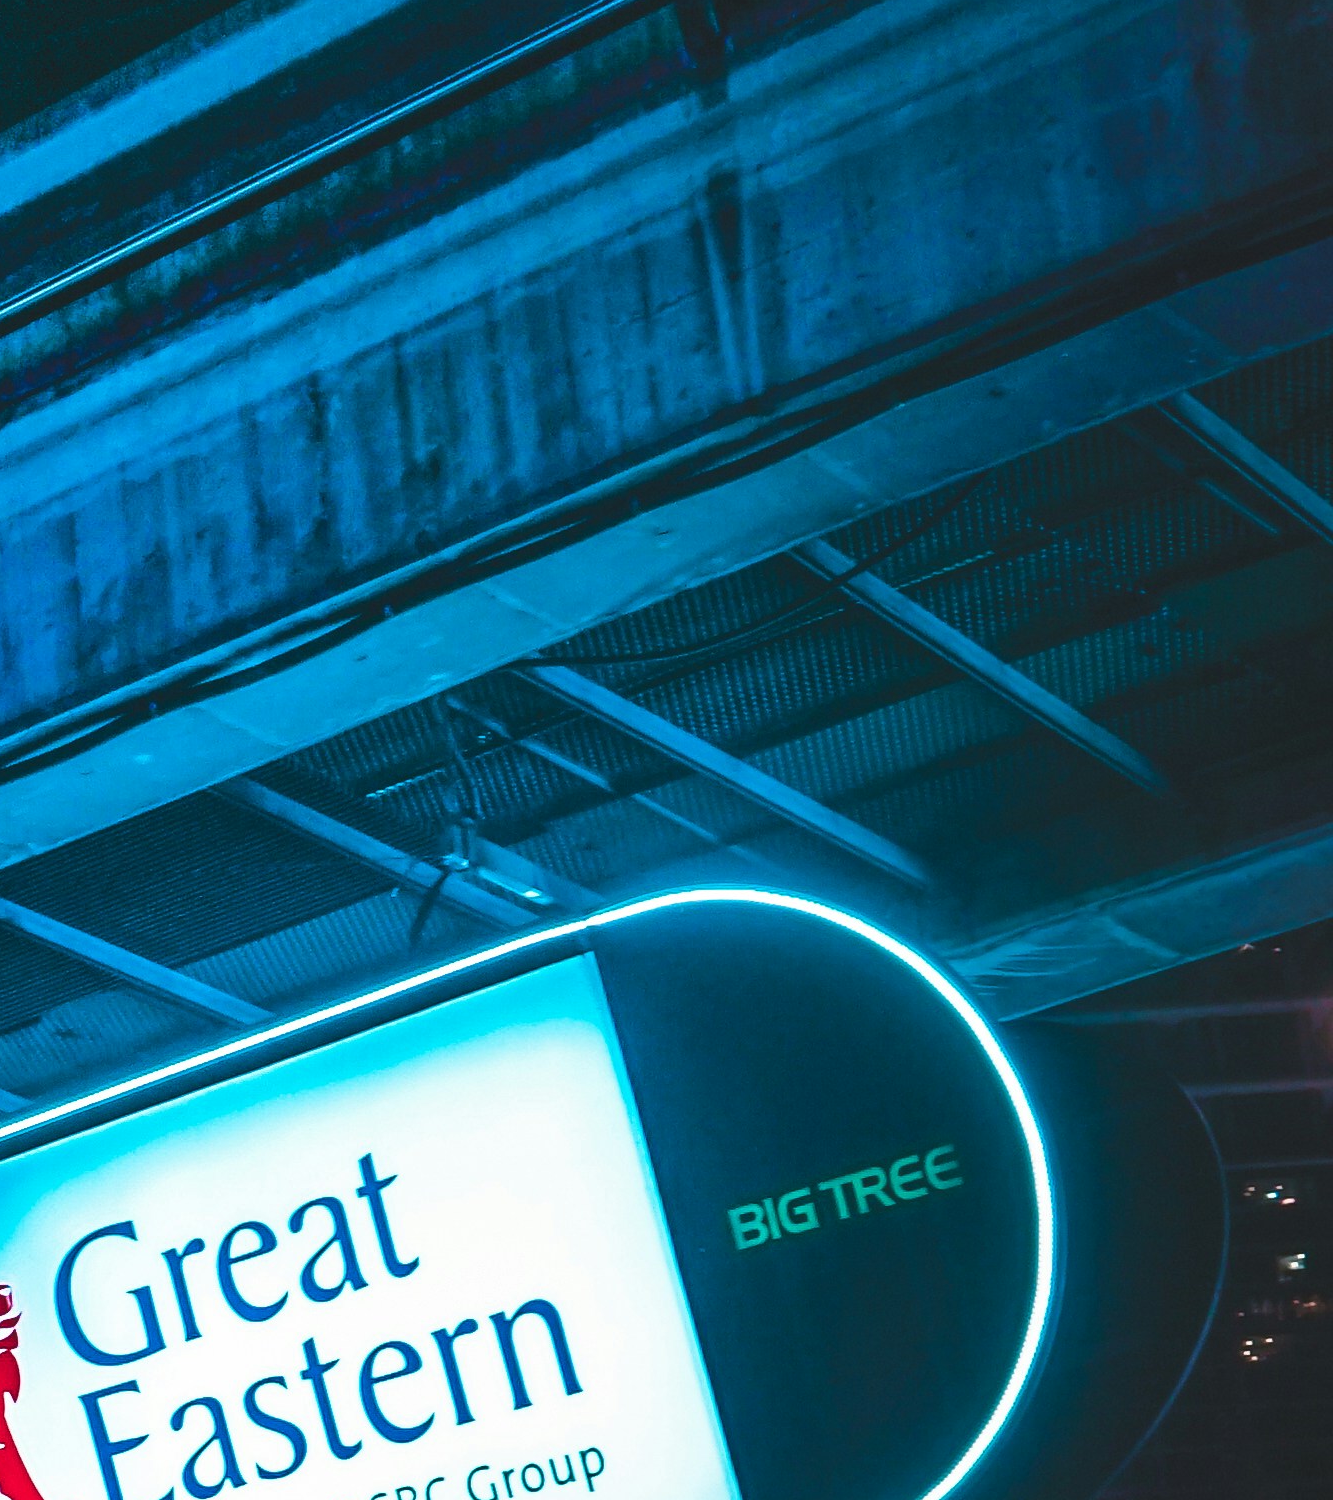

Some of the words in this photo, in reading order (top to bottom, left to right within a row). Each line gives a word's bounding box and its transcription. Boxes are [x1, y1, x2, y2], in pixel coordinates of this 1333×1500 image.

[55, 1153, 419, 1366] Great
[728, 1188, 819, 1249] BIG
[818, 1147, 961, 1219] TREE
